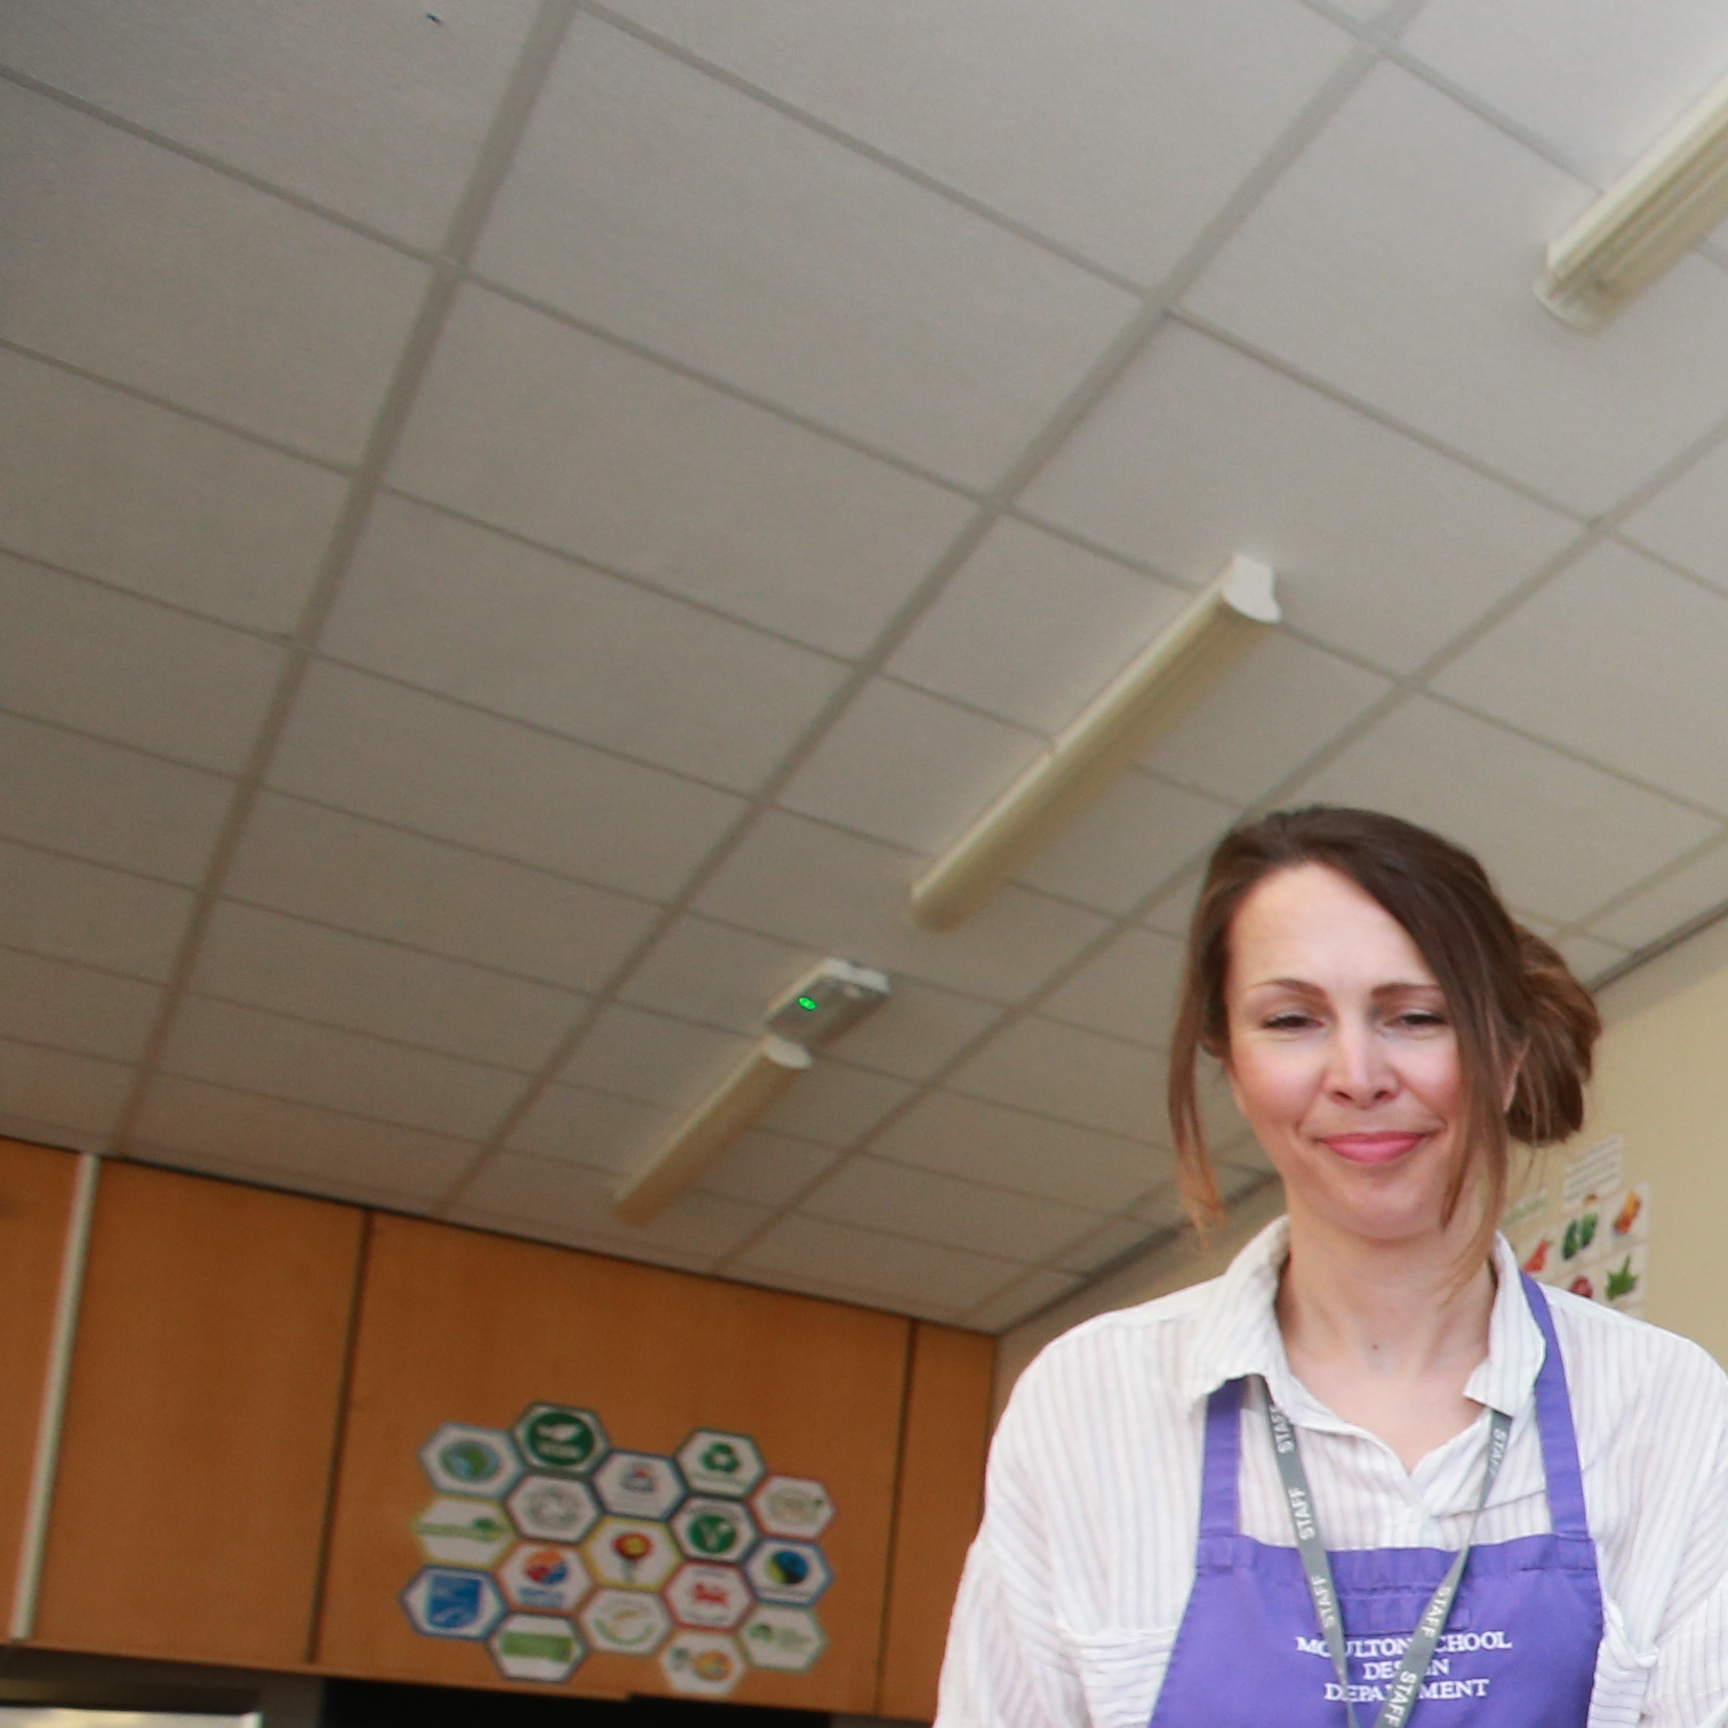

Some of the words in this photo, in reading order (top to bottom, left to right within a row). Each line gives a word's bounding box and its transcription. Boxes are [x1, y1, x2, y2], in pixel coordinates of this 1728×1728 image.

[1288, 1486, 1317, 1541] STAFF
[1311, 1575, 1335, 1629] STAFF
[1421, 1586, 1451, 1639] STAFF
[1435, 1631, 1513, 1653] CHOOL
[1324, 1678, 1490, 1702] DEPAMENT
[1384, 1670, 1417, 1728] STAFF
